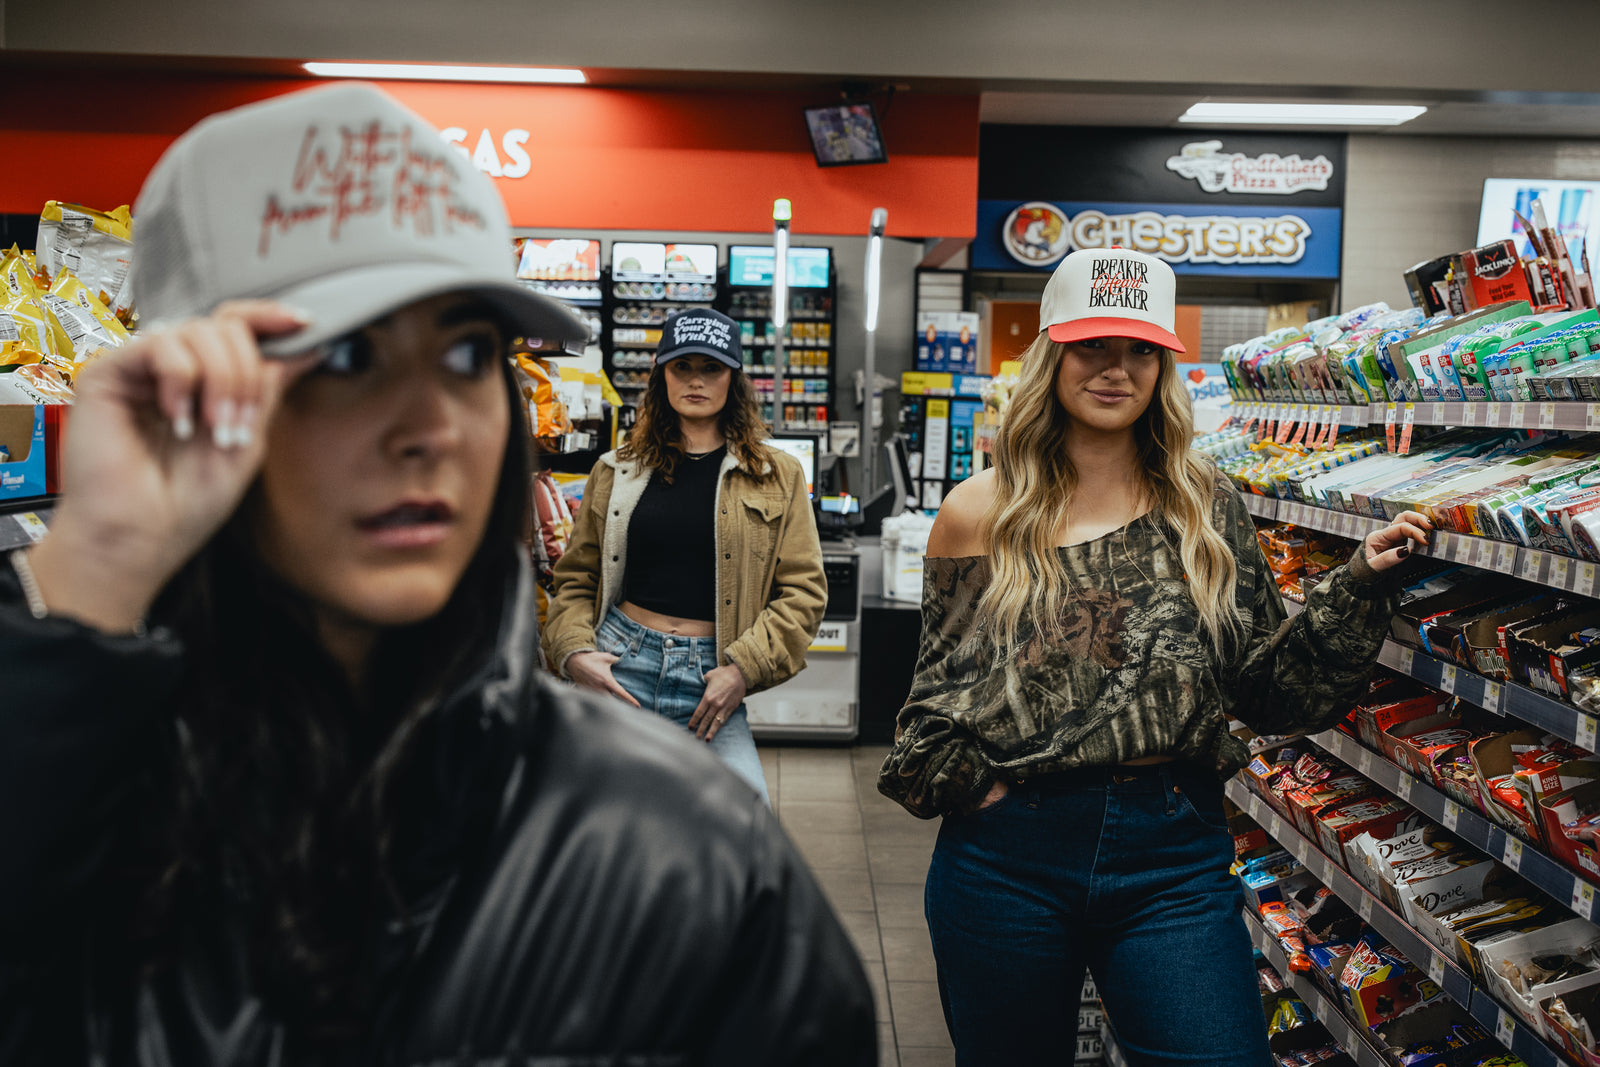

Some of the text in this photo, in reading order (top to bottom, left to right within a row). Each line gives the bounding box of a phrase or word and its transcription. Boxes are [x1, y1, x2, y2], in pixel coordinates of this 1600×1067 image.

[1231, 171, 1277, 188] Pizza
[1091, 258, 1149, 284] BREAKER
[1474, 263, 1494, 277] JACK
[1093, 272, 1143, 296] Heart
[1488, 283, 1515, 296] Feed Your
[1088, 286, 1149, 312] BREAKER
[673, 324, 732, 342] Your Love
[676, 316, 731, 333] Carrying
[674, 332, 729, 350] With Me
[1461, 353, 1472, 362] 50
[1541, 774, 1559, 784] KING
[1543, 781, 1560, 792] SIZE
[1379, 833, 1421, 859] Dove
[1422, 885, 1466, 912] Dove
